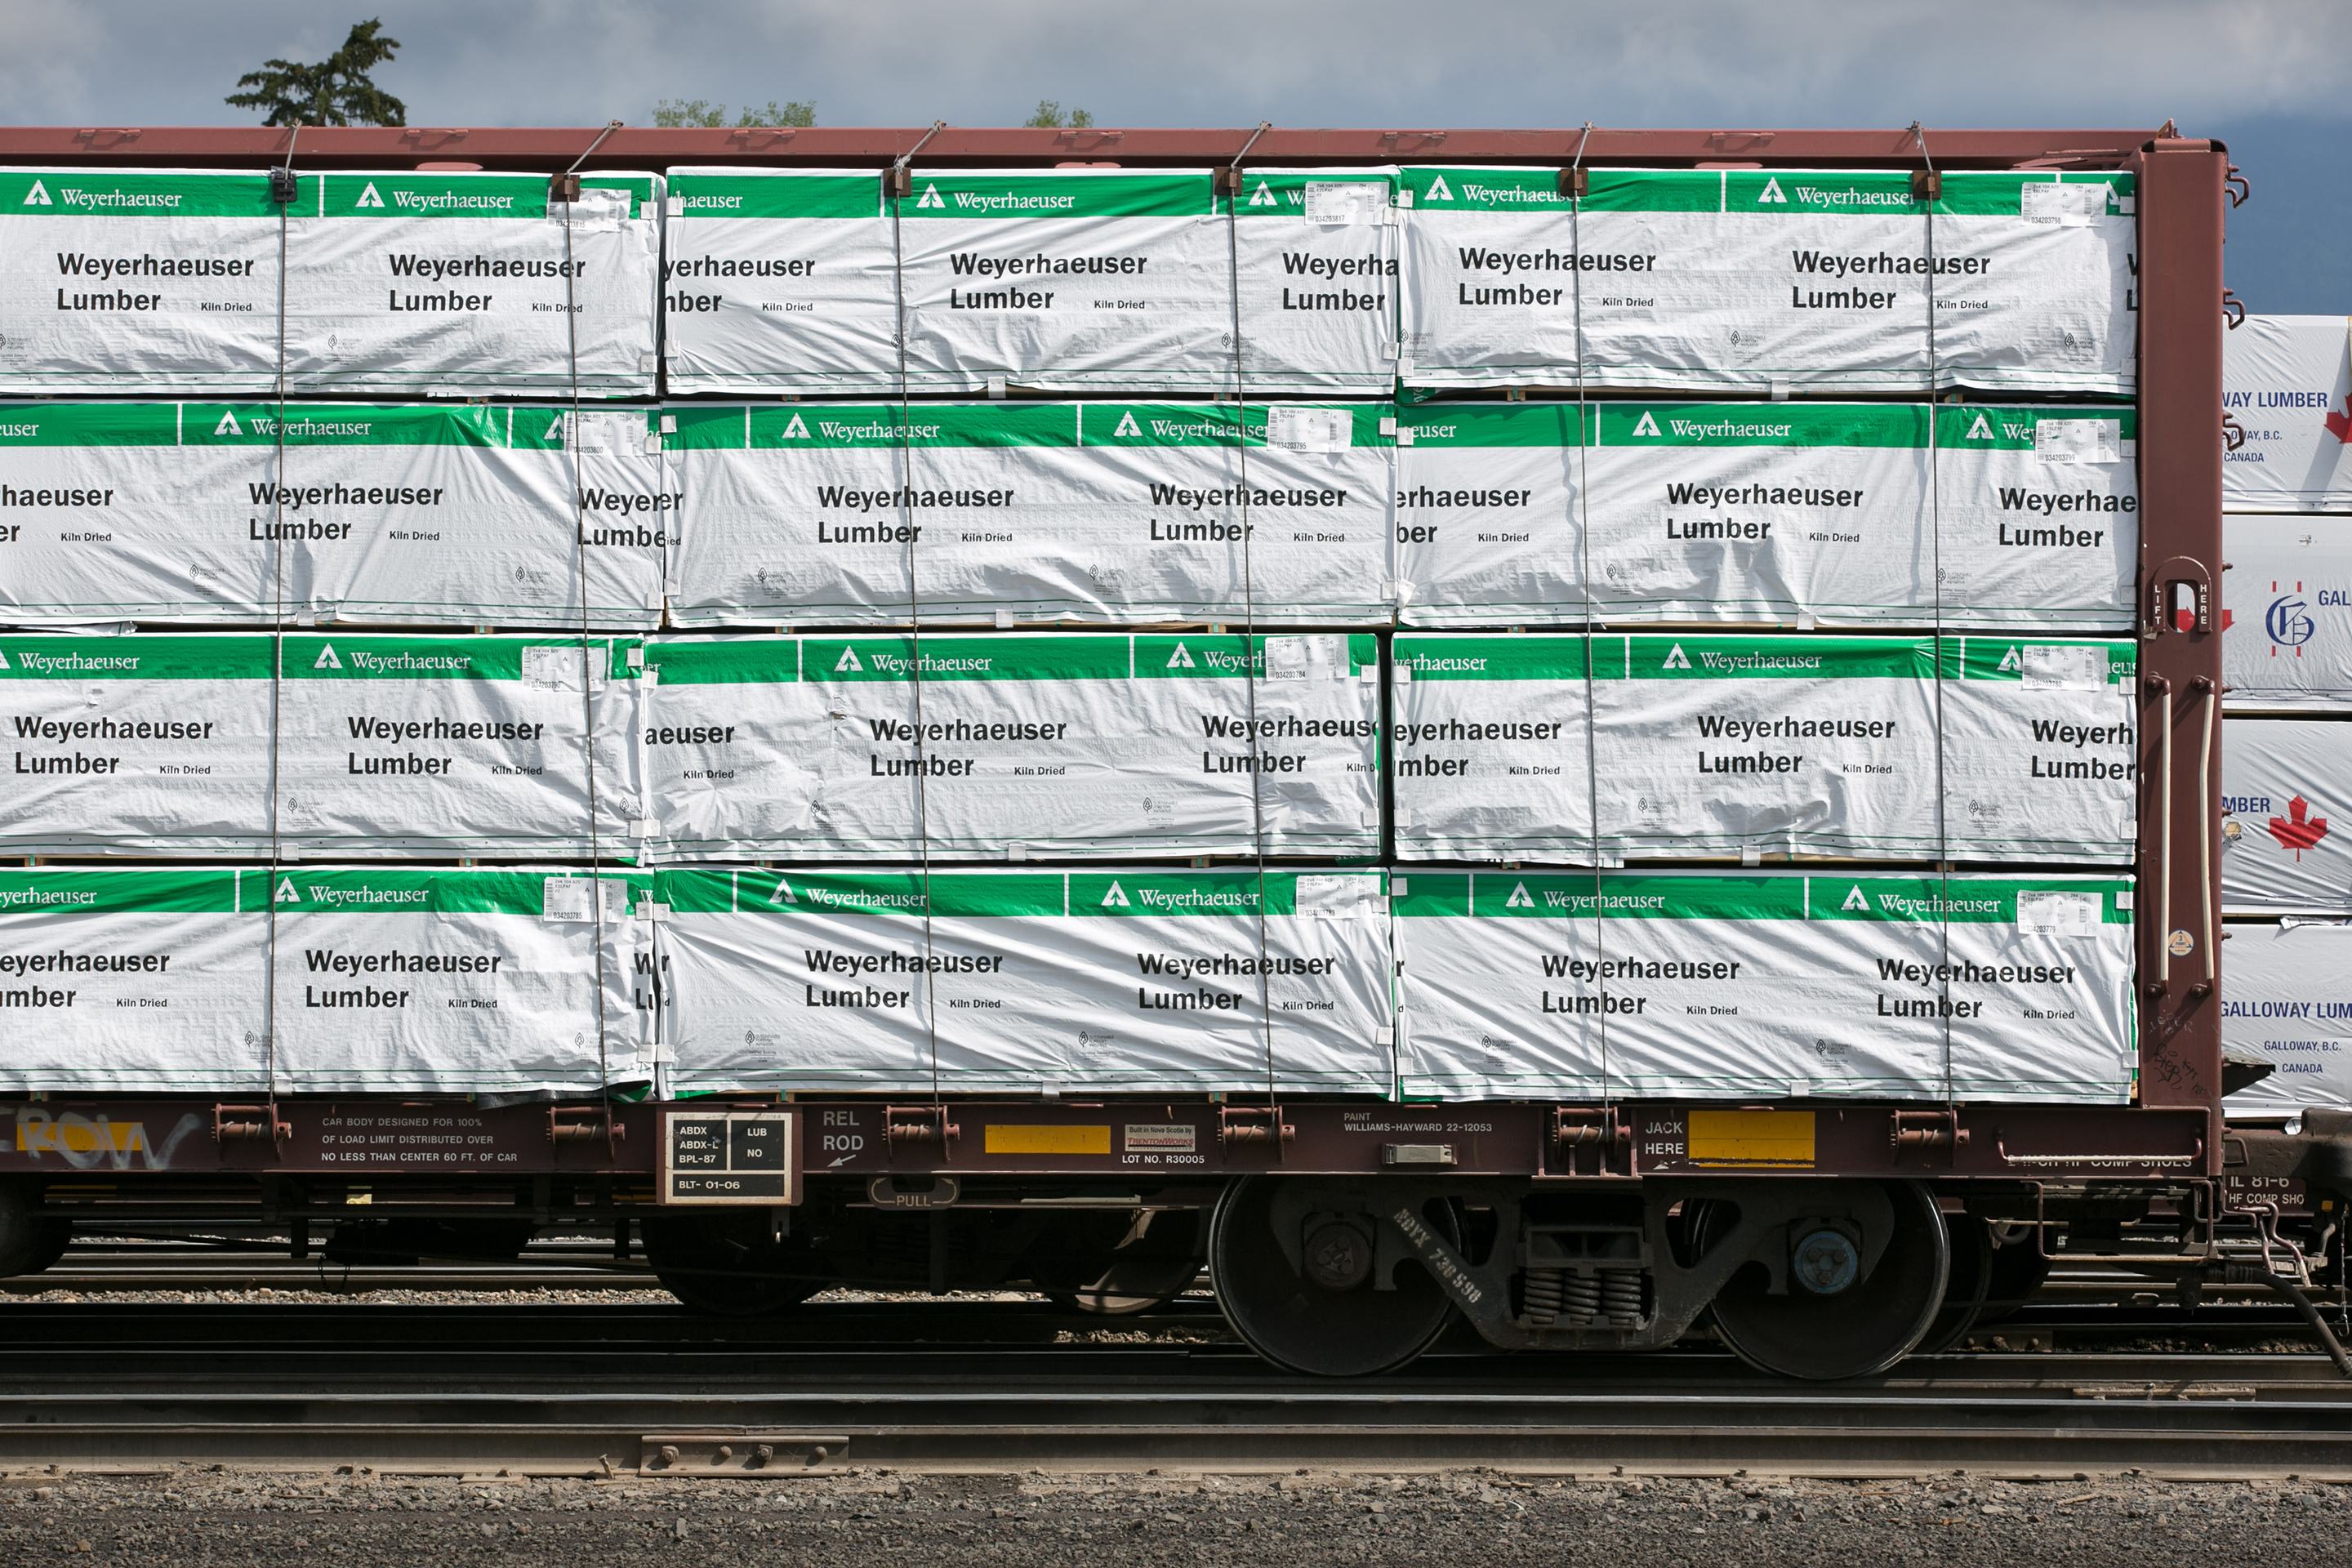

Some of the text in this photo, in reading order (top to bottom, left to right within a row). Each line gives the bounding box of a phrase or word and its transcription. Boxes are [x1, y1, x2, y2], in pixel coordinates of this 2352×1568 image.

[61, 189, 181, 210] Weyerhaeuser
[394, 191, 513, 212] Weyerhaeuser
[954, 192, 1075, 212] Weyerhaeuser
[58, 253, 253, 280] Weyerhaeuser
[951, 253, 1147, 278] Weyerhaeuser
[58, 289, 160, 310] Lumber
[225, 303, 252, 311] Dried
[390, 290, 492, 310] Lumber
[951, 287, 1054, 309] Lumber
[1284, 288, 1384, 310] Lumber
[1627, 298, 1653, 306] Dried
[1793, 287, 1895, 309] Lumber
[2259, 392, 2327, 407] LUMBER
[1670, 420, 1791, 440] Weyerhaeuser
[2264, 431, 2282, 439] B.C.
[2225, 453, 2264, 461] CANADA
[1397, 486, 1530, 507] erhaeuser
[1668, 483, 1863, 509] Weyerhaeuser
[1999, 488, 2136, 515] Weyerhae
[390, 531, 439, 540] Kiln Dried
[1317, 533, 1344, 541] Dried
[1668, 518, 1770, 539] Lumber
[1810, 532, 1859, 541] Kiln Dried
[2000, 523, 2103, 546] Lumber
[2319, 590, 2350, 605] GAL
[19, 653, 140, 674] Weyerhaeuser
[350, 653, 470, 673] Weyerhaeuser
[1700, 652, 1820, 673] Weyerhaeuser
[15, 717, 212, 743] Weyerhaeuser
[348, 717, 543, 744] Weyerhaeuser
[1394, 719, 1561, 746] eyerhaeuser
[1698, 716, 1895, 742] Weyerhaeuser
[16, 752, 118, 773] Lumber
[1015, 767, 1065, 775] Kiln Dried
[310, 886, 429, 906] Weyerhaeuser
[806, 889, 926, 909] Weyerhaeuser
[1138, 889, 1259, 910] Weyerhaeuser
[305, 950, 501, 977] Weyerhaeuser
[307, 986, 408, 1007] Lumber
[807, 985, 909, 1007] Lumber
[2221, 1001, 2310, 1018] GALLOWAY
[2264, 1041, 2341, 1052] GALLOWAY, B.C.
[2282, 1063, 2323, 1073] CANADA
[379, 1118, 428, 1126] DESIGNED
[434, 1118, 452, 1126] FOR
[824, 1111, 859, 1125] REL
[1646, 1122, 1682, 1134] JACK
[323, 1135, 335, 1143] OF
[341, 1135, 365, 1143] LOAD
[679, 1126, 706, 1134] ABDX
[747, 1128, 767, 1136] LUB
[679, 1141, 719, 1150] ABDX-L
[824, 1135, 863, 1150] ROD
[1646, 1143, 1683, 1154] HERE
[480, 1153, 493, 1161] OF
[679, 1155, 715, 1163] BPL-87
[747, 1149, 762, 1157] NO
[1145, 1155, 1161, 1164] NO.
[898, 1196, 930, 1206] PULL
[2229, 1193, 2243, 1204] HF
[2247, 1193, 2278, 1204] COMP
